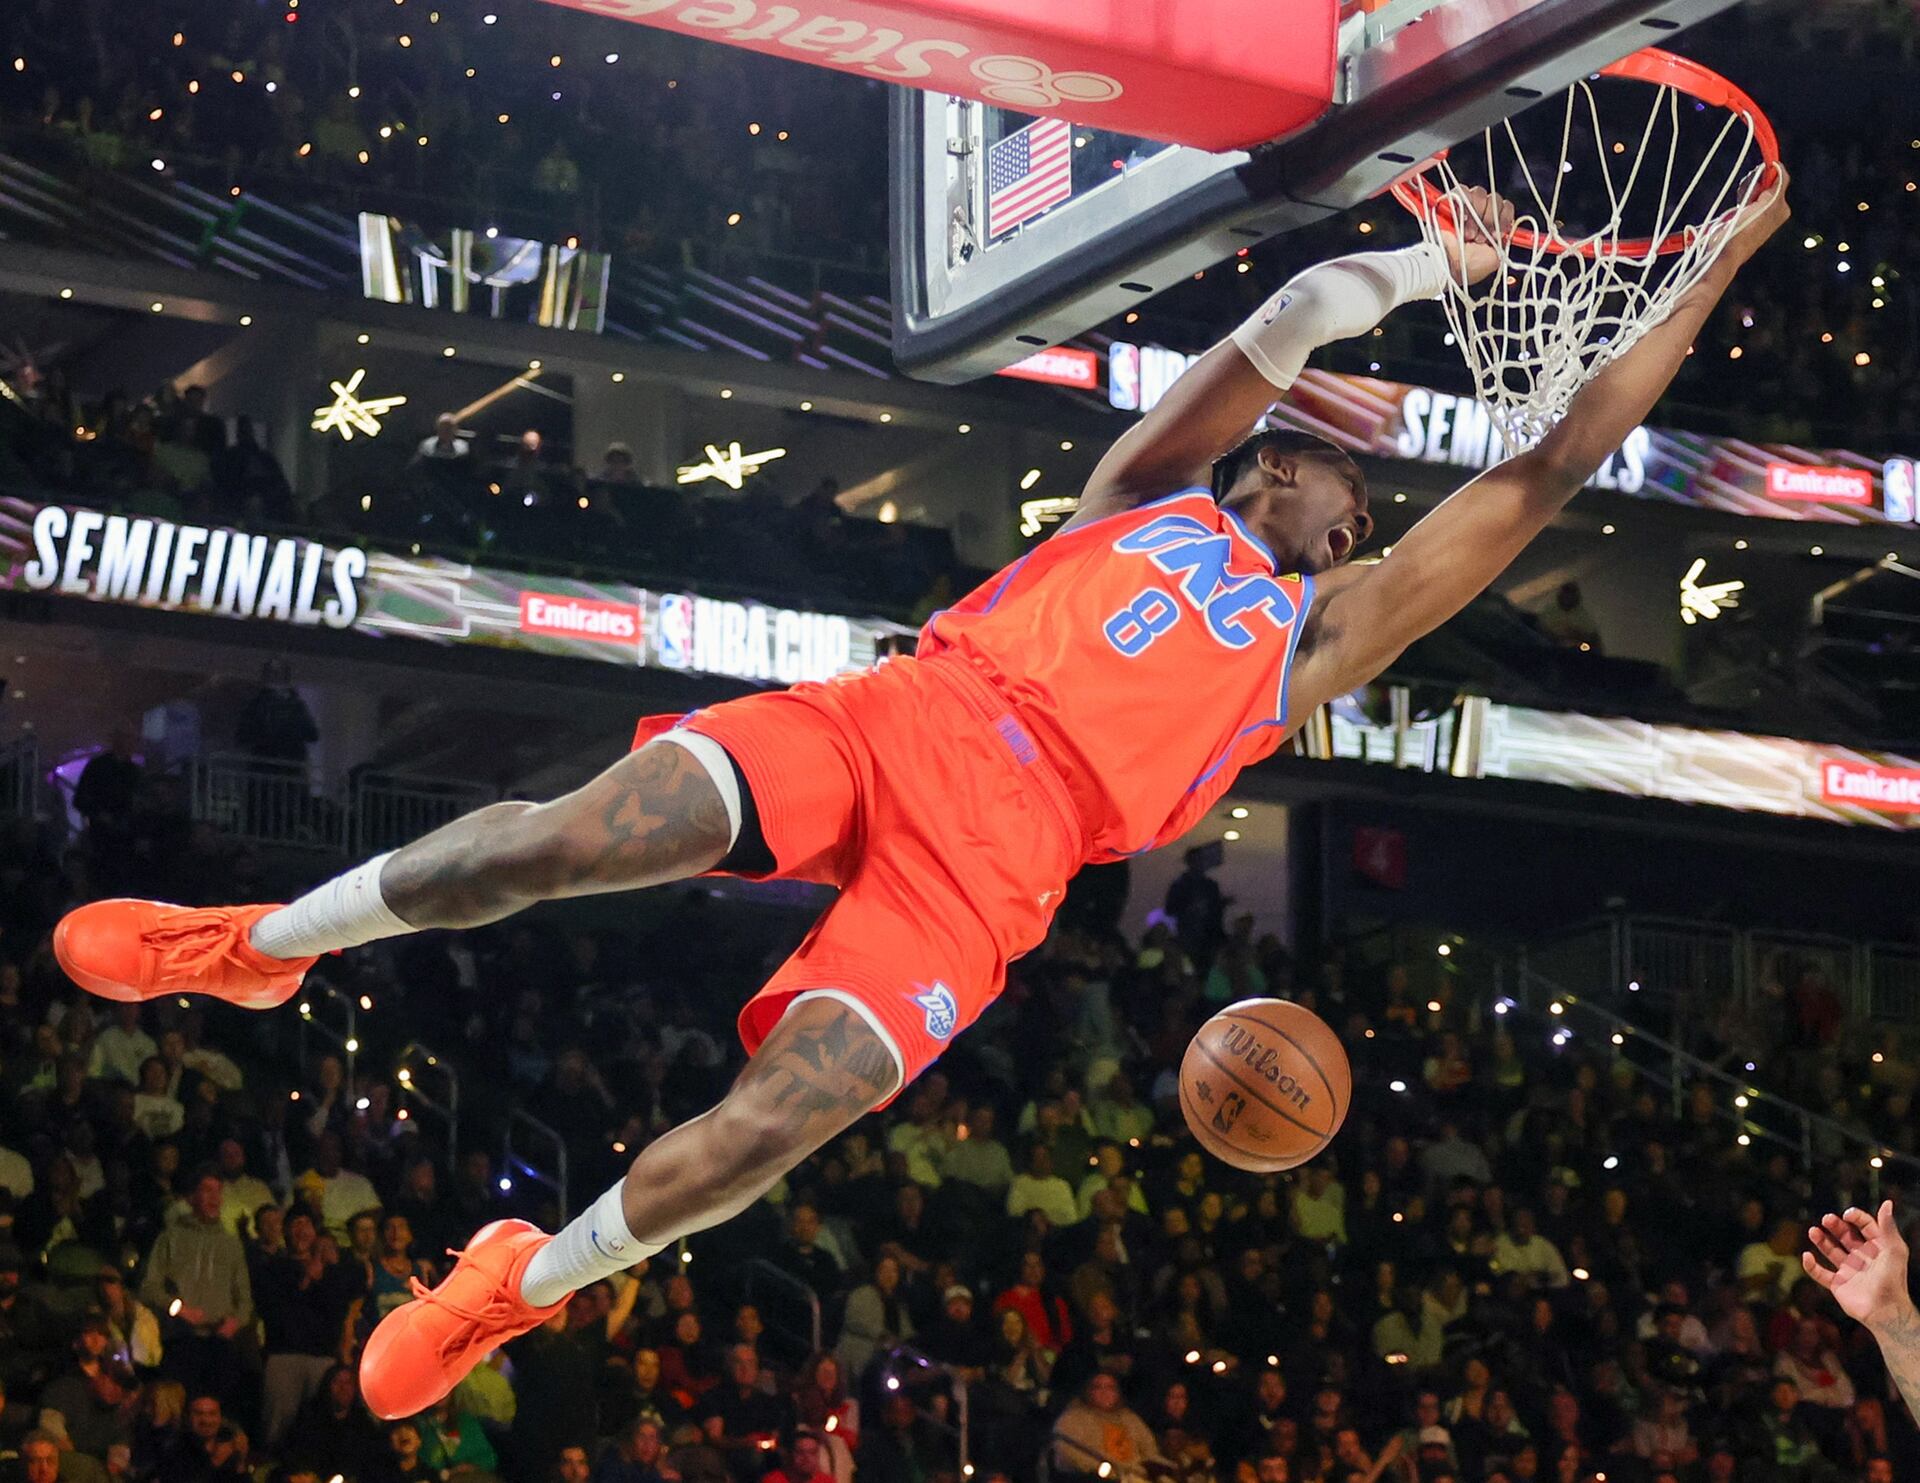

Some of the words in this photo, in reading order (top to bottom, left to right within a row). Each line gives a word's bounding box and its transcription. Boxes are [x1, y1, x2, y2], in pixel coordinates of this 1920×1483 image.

[676, 0, 970, 78] State
[1772, 467, 1866, 498] Emirates
[24, 505, 367, 629] SEMIFINALS
[1112, 514, 1297, 649] OKC
[527, 597, 635, 637] Emirates
[693, 596, 772, 682] NBA
[774, 609, 851, 684] CUP
[1103, 587, 1181, 657] 8
[1826, 764, 1920, 804] Emirate
[1221, 1023, 1311, 1111] Wilson
